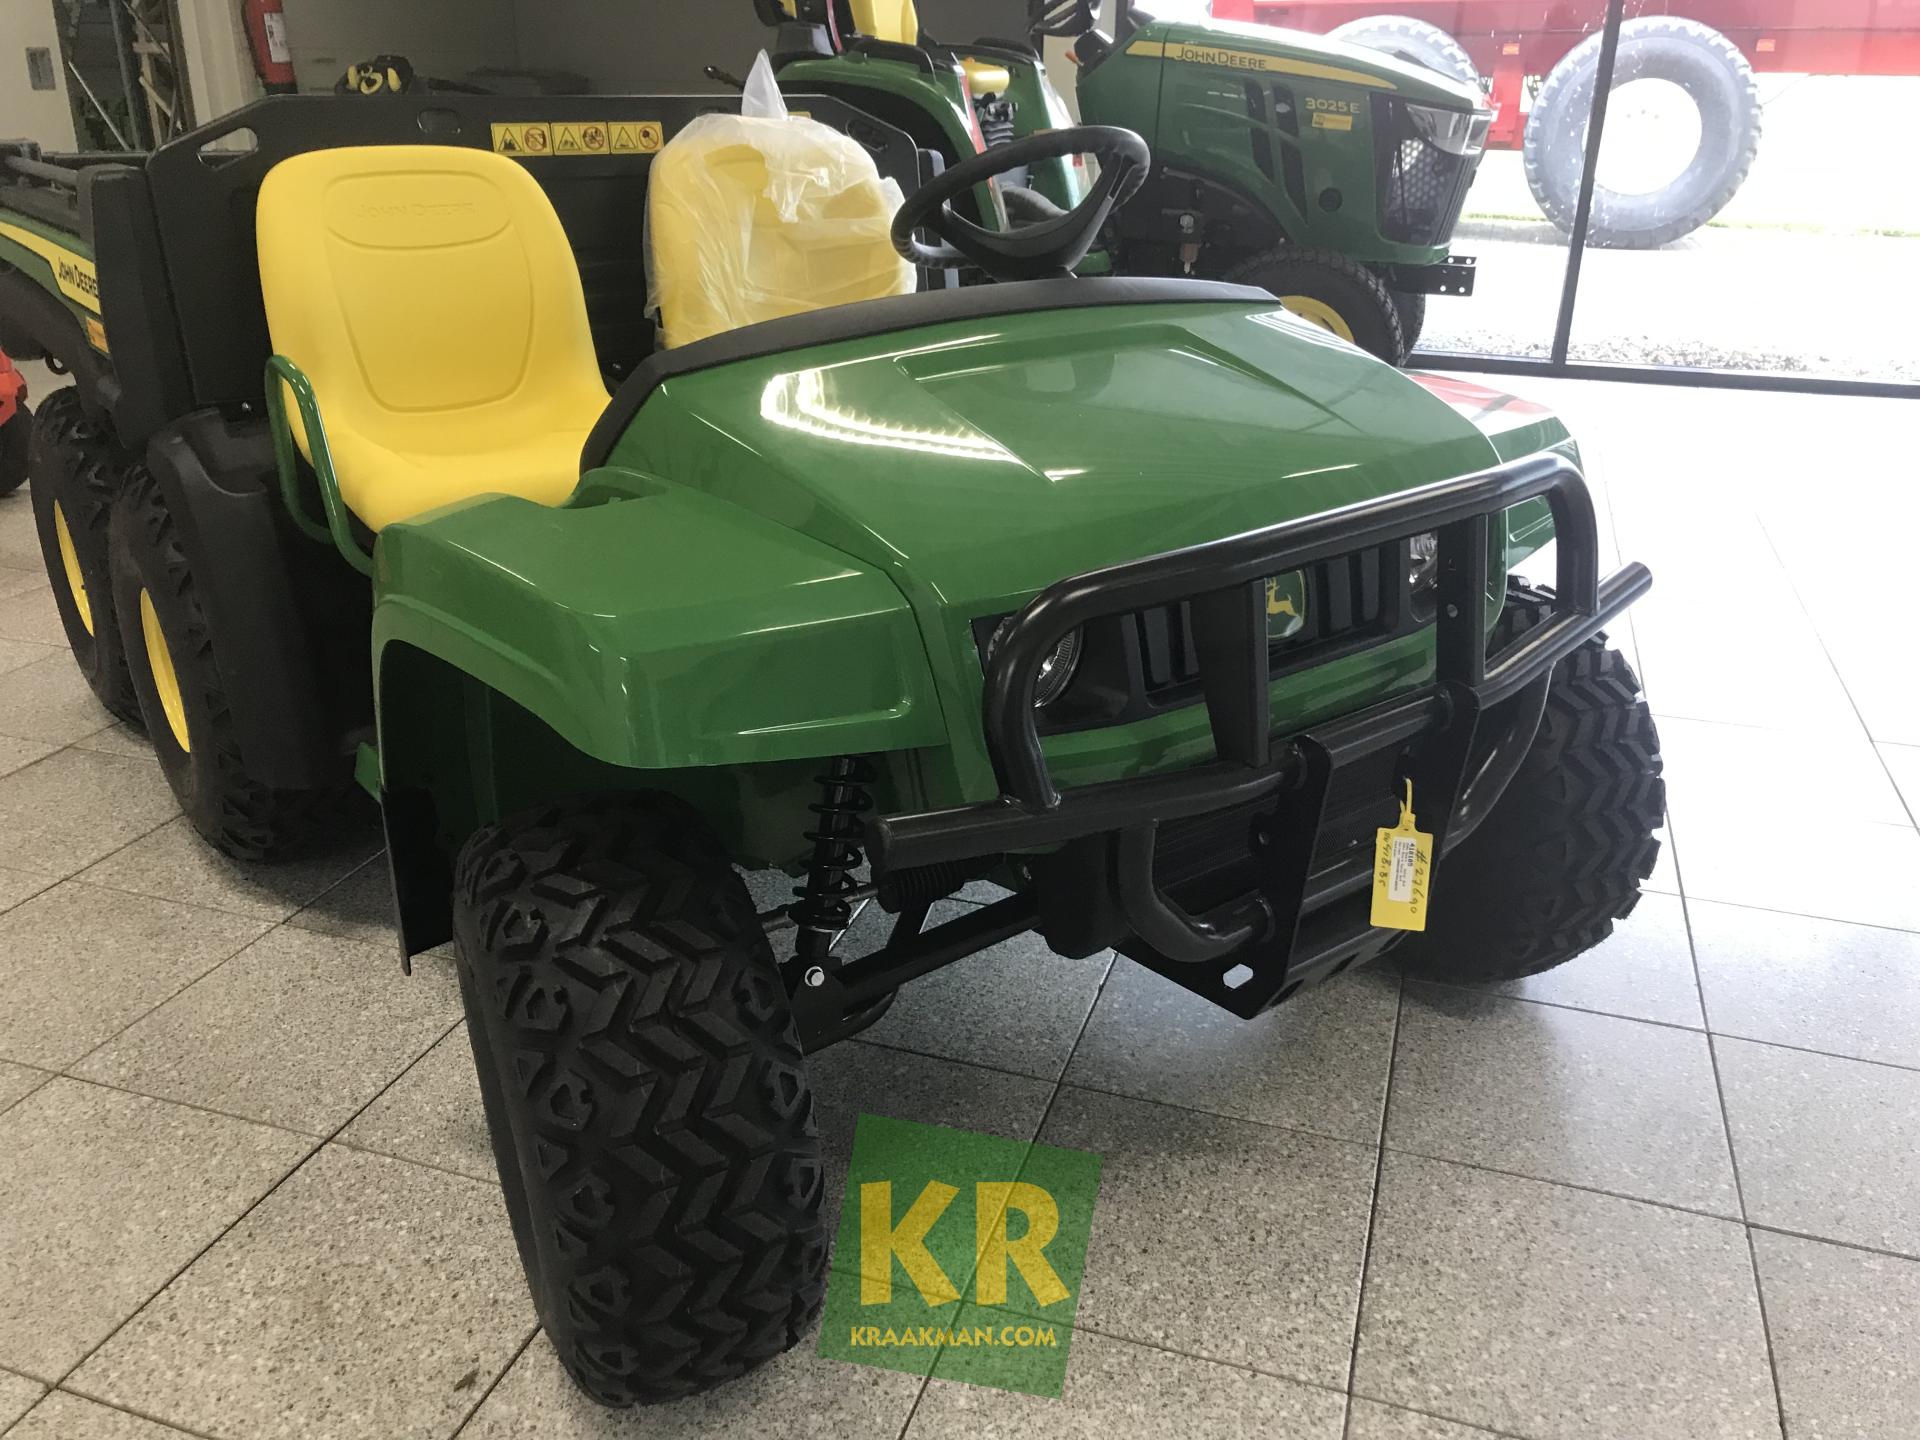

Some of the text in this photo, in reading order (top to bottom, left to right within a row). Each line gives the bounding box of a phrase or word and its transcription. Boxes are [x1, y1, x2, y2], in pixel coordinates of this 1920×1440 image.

[1176, 46, 1267, 69] JOHN DEERE
[59, 256, 75, 285] JOHN
